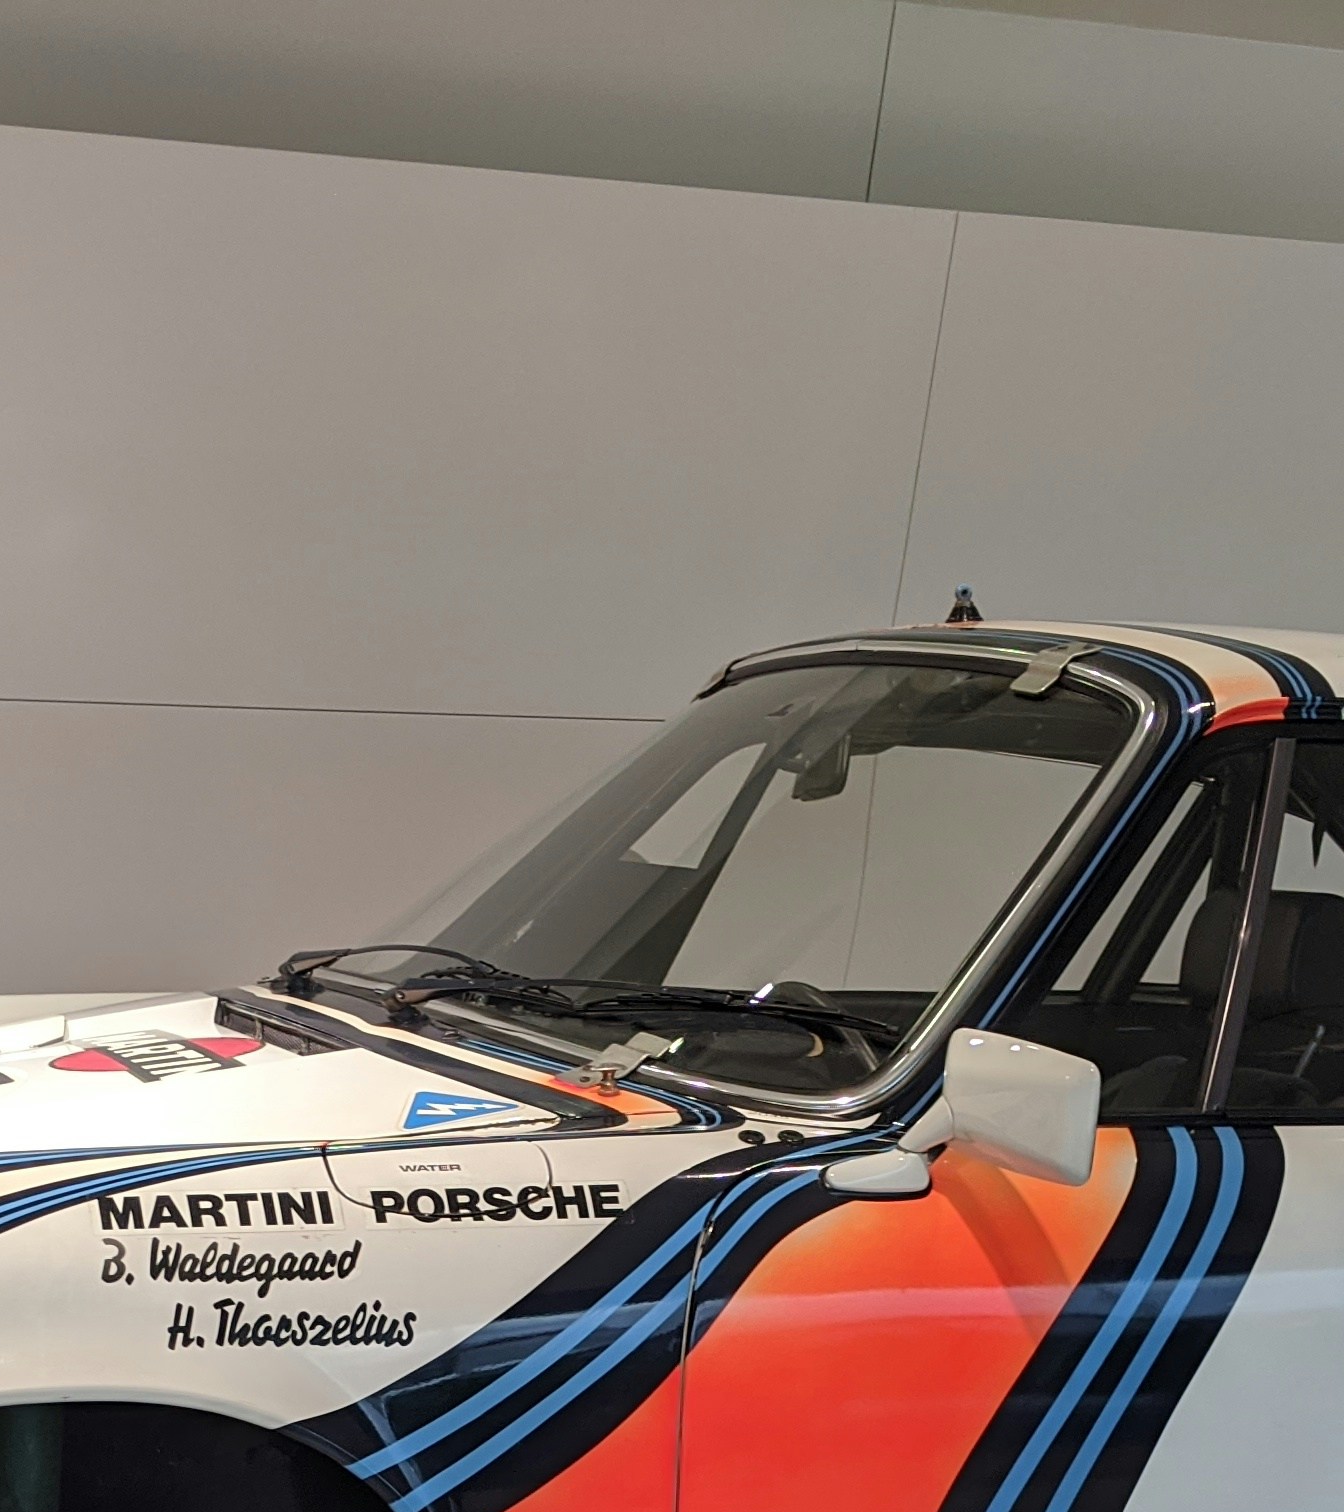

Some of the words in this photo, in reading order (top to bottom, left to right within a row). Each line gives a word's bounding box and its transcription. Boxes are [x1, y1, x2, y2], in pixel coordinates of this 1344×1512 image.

[399, 1163, 461, 1173] WATER
[98, 1190, 335, 1230] MARTINI
[370, 1184, 625, 1223] PORSCHE
[167, 1303, 205, 1350] H.
